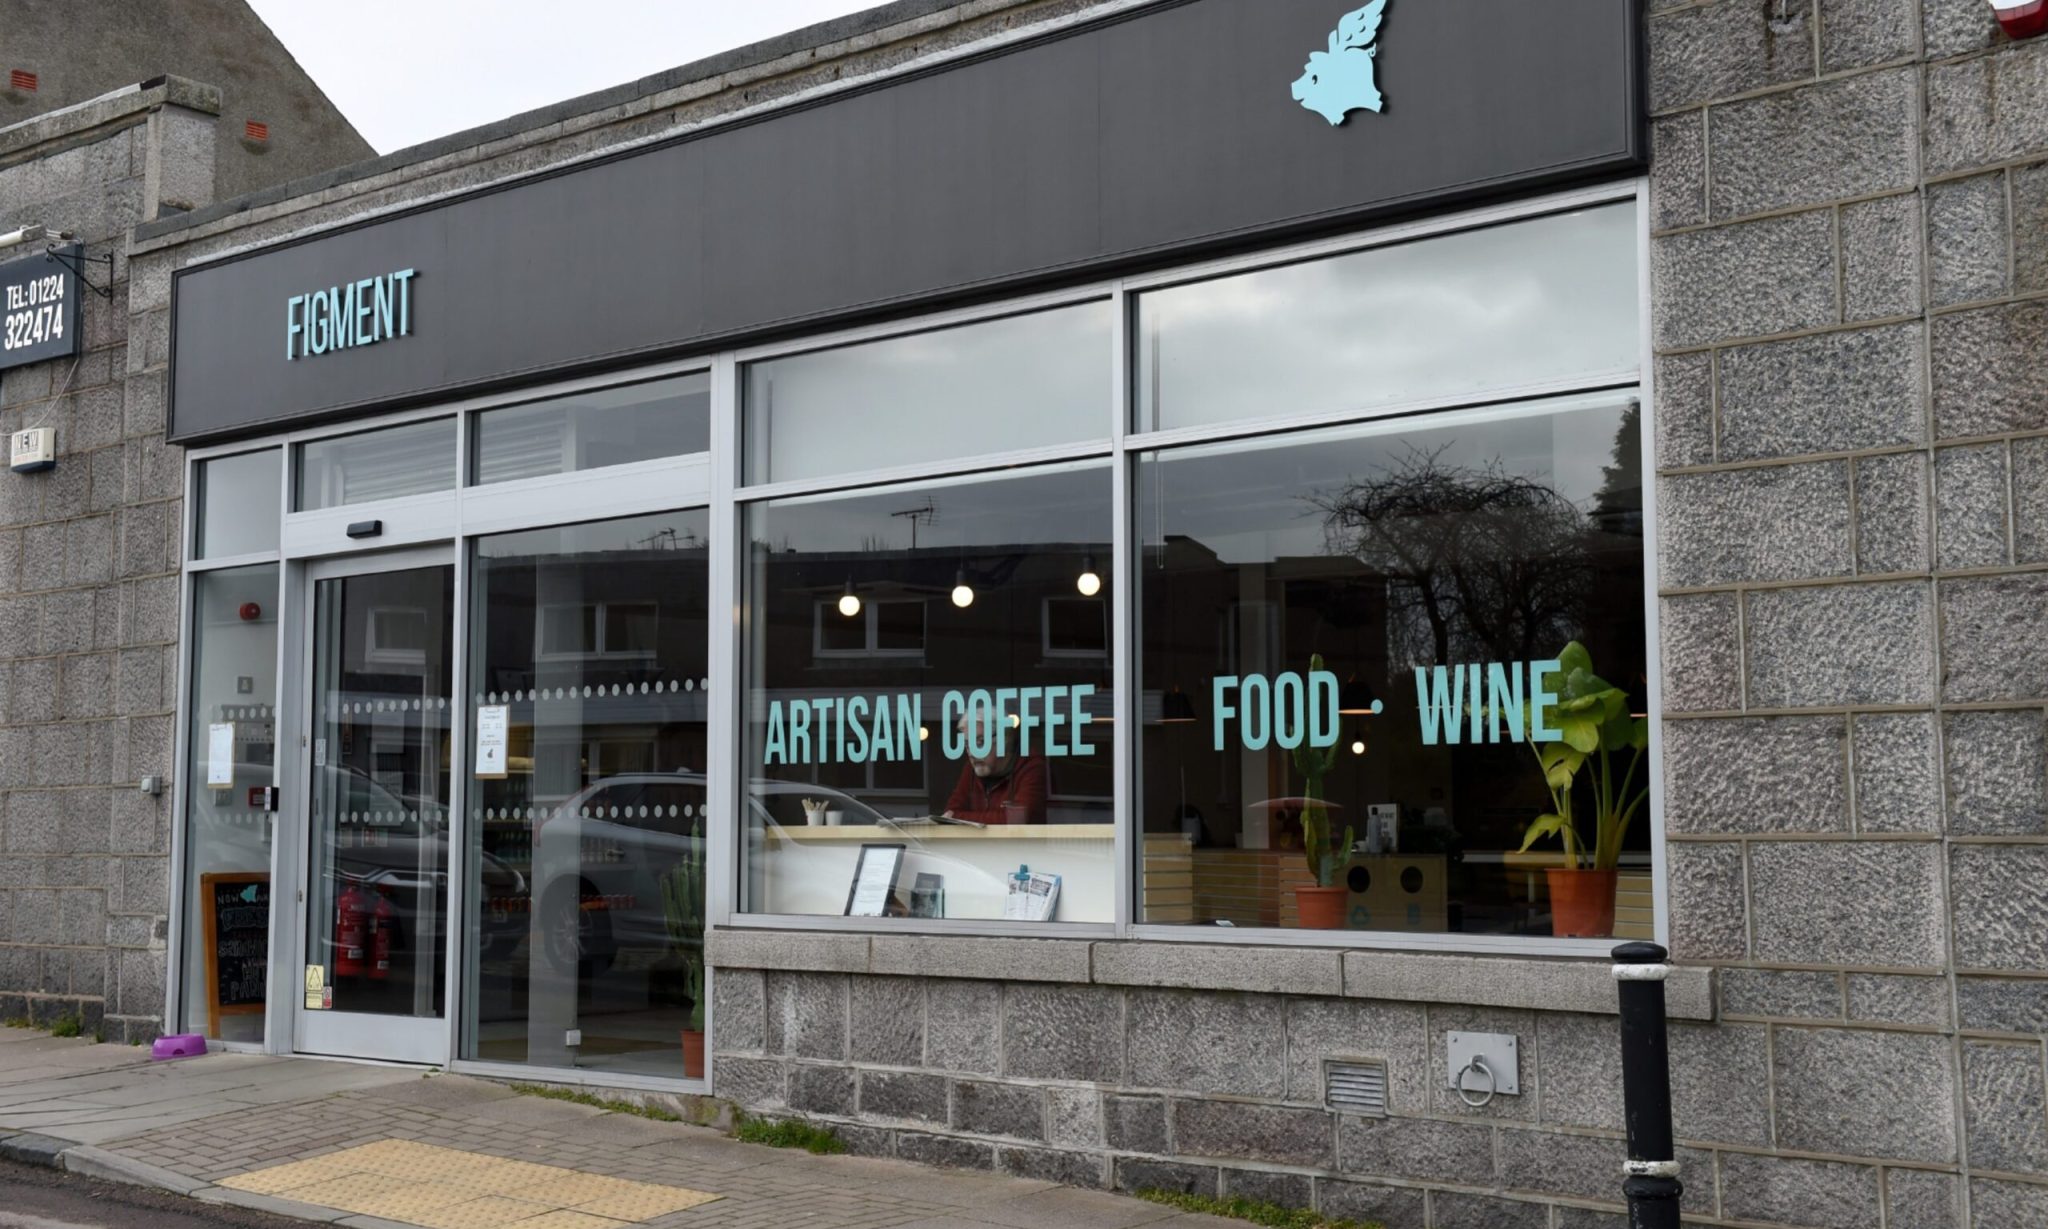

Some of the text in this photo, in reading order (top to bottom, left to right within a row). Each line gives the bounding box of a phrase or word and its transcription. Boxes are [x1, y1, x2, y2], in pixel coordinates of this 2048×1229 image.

[4, 303, 63, 351] 322474
[287, 268, 414, 361] FIGMENT
[764, 684, 1095, 765] ARTISAN COFFEE
[1213, 670, 1340, 751] FOOD
[1415, 659, 1563, 746] WINE
